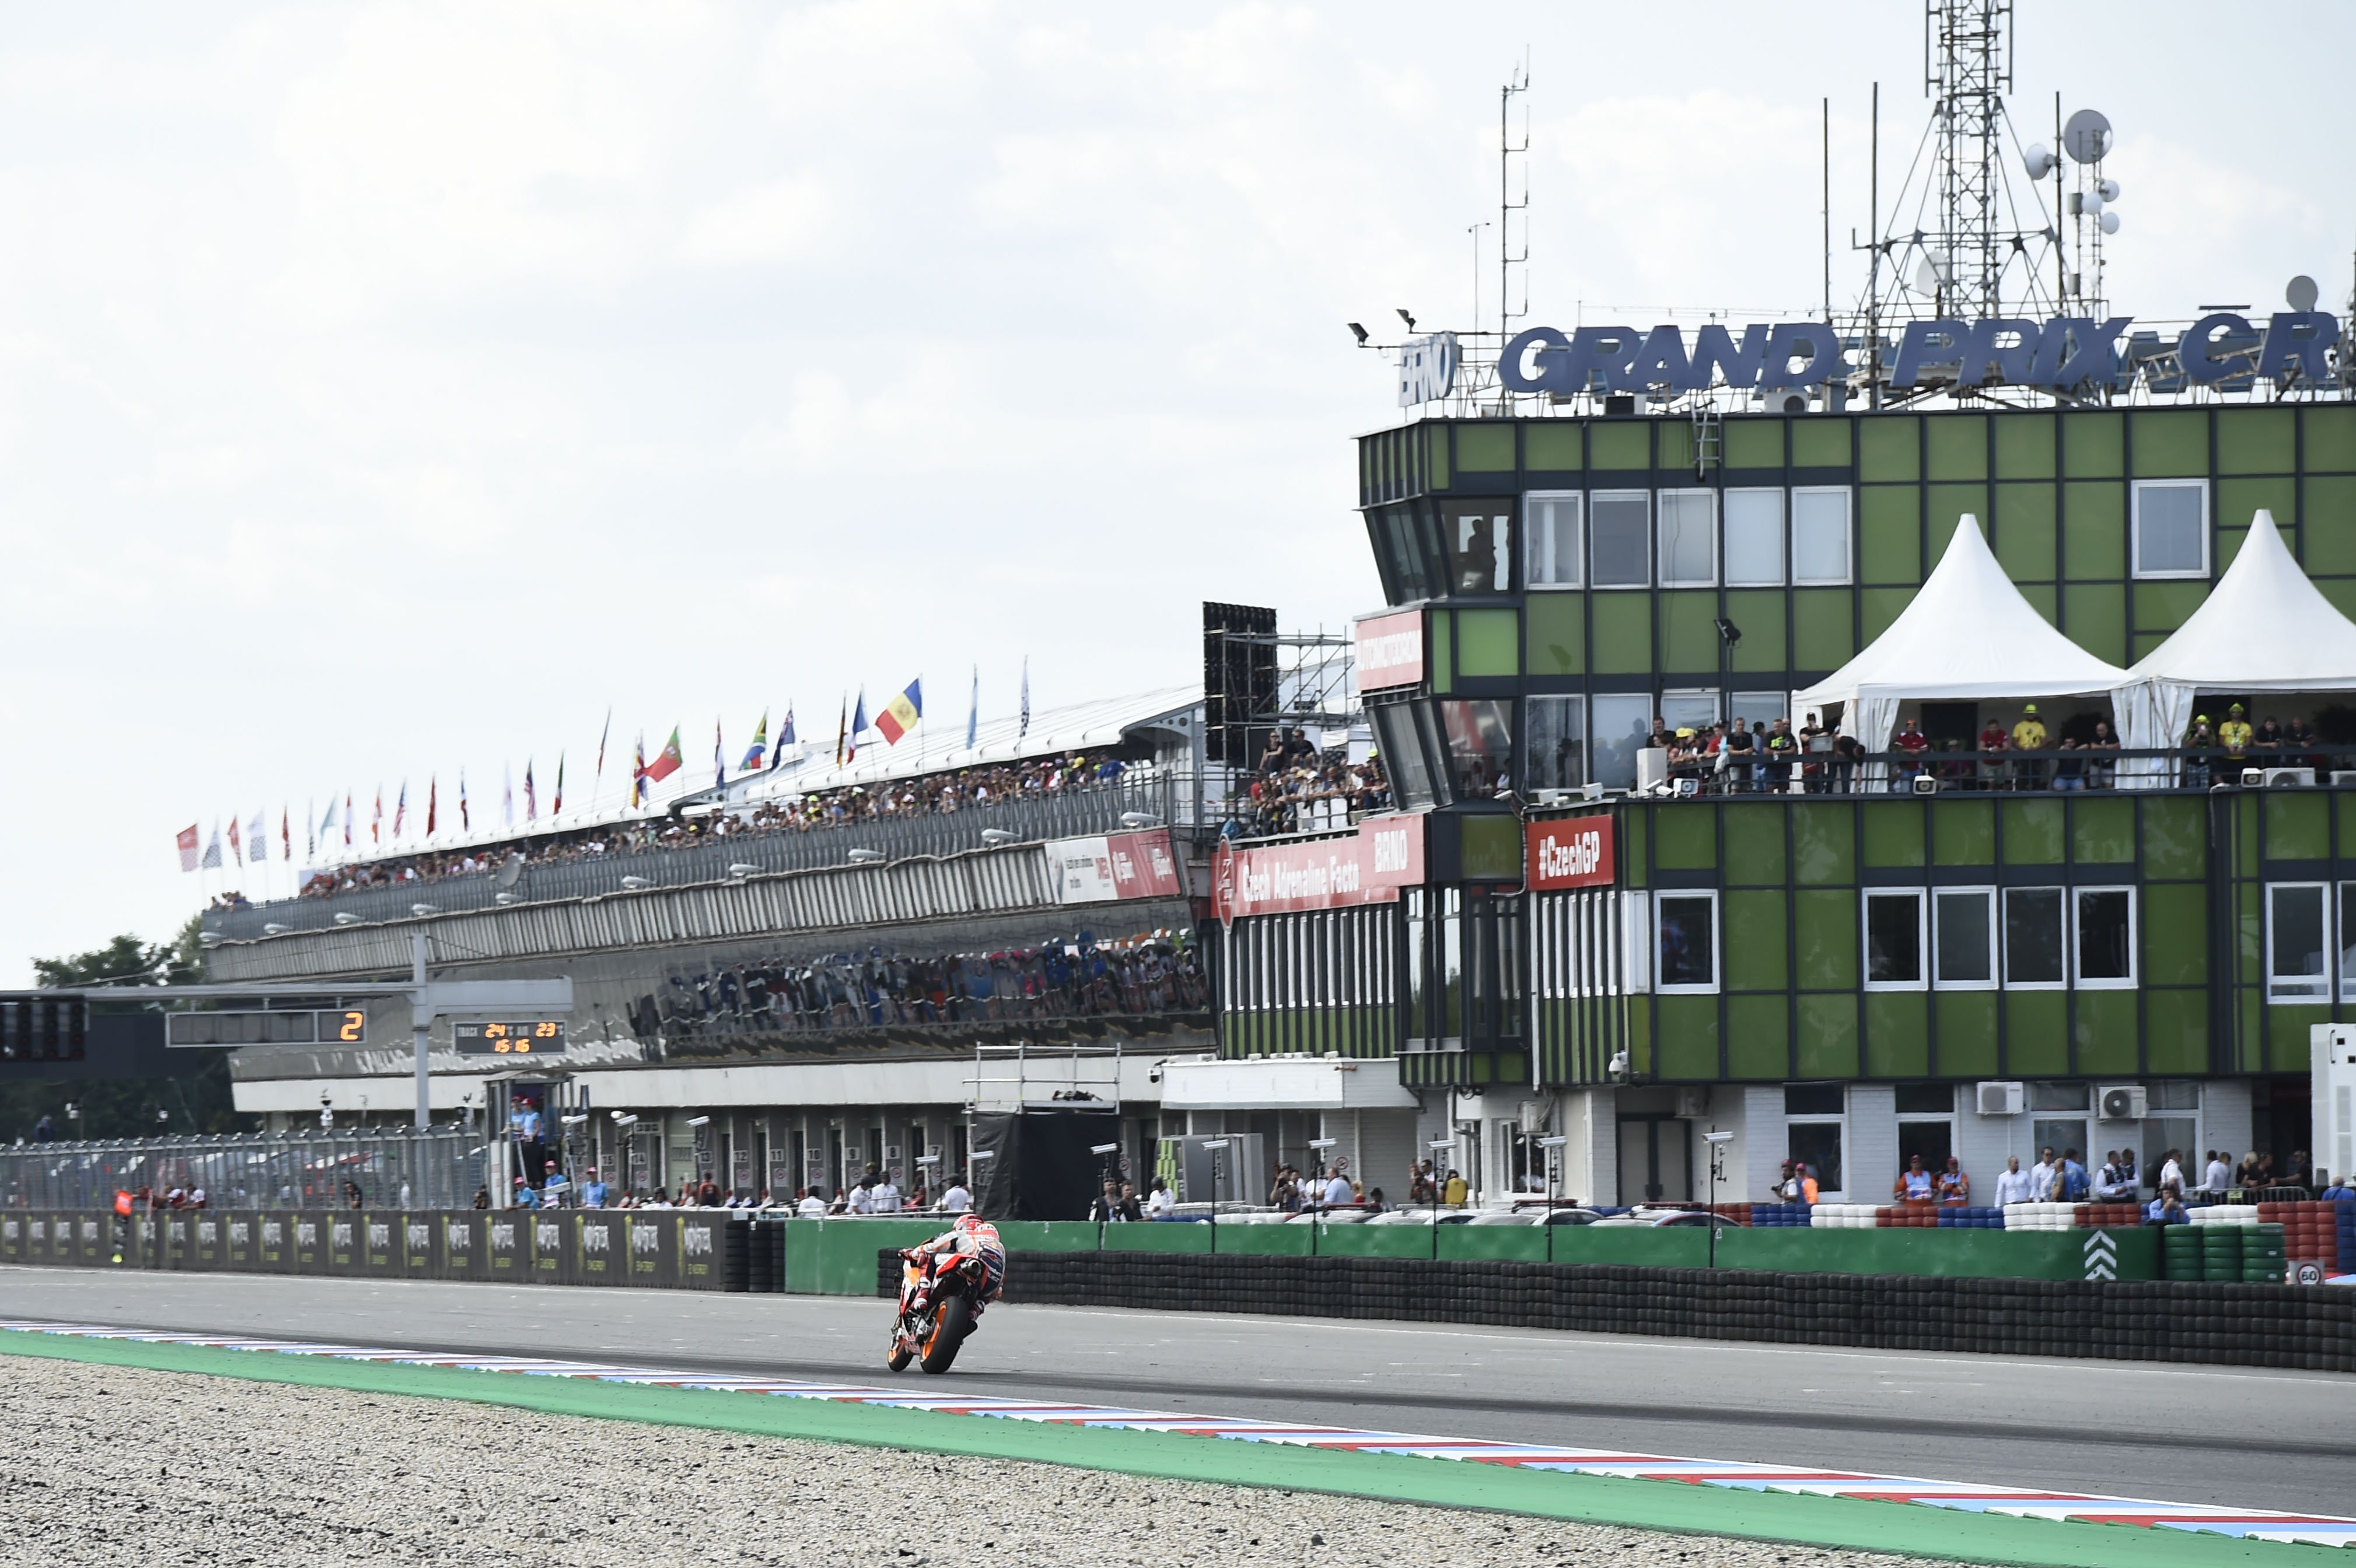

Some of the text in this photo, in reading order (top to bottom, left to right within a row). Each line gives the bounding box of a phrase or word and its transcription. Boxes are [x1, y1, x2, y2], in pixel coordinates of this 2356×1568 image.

[1498, 323, 1840, 393] GRAND
[1890, 317, 2135, 387] PRIX
[1399, 331, 1457, 407] BRNO
[1375, 829, 1408, 873] BRNO
[1539, 831, 1600, 881] #CzechGP
[1242, 863, 1270, 902] Czech
[1274, 859, 1327, 900] Adrenaline
[1330, 856, 1359, 894] Facto
[340, 1011, 363, 1041] 2
[485, 1023, 506, 1038] 24
[536, 1022, 556, 1038] 23
[735, 1152, 747, 1161] 12
[771, 1150, 782, 1160] 11
[808, 1149, 820, 1160] 10
[932, 1146, 939, 1156] 7
[2301, 1270, 2317, 1281] 60
